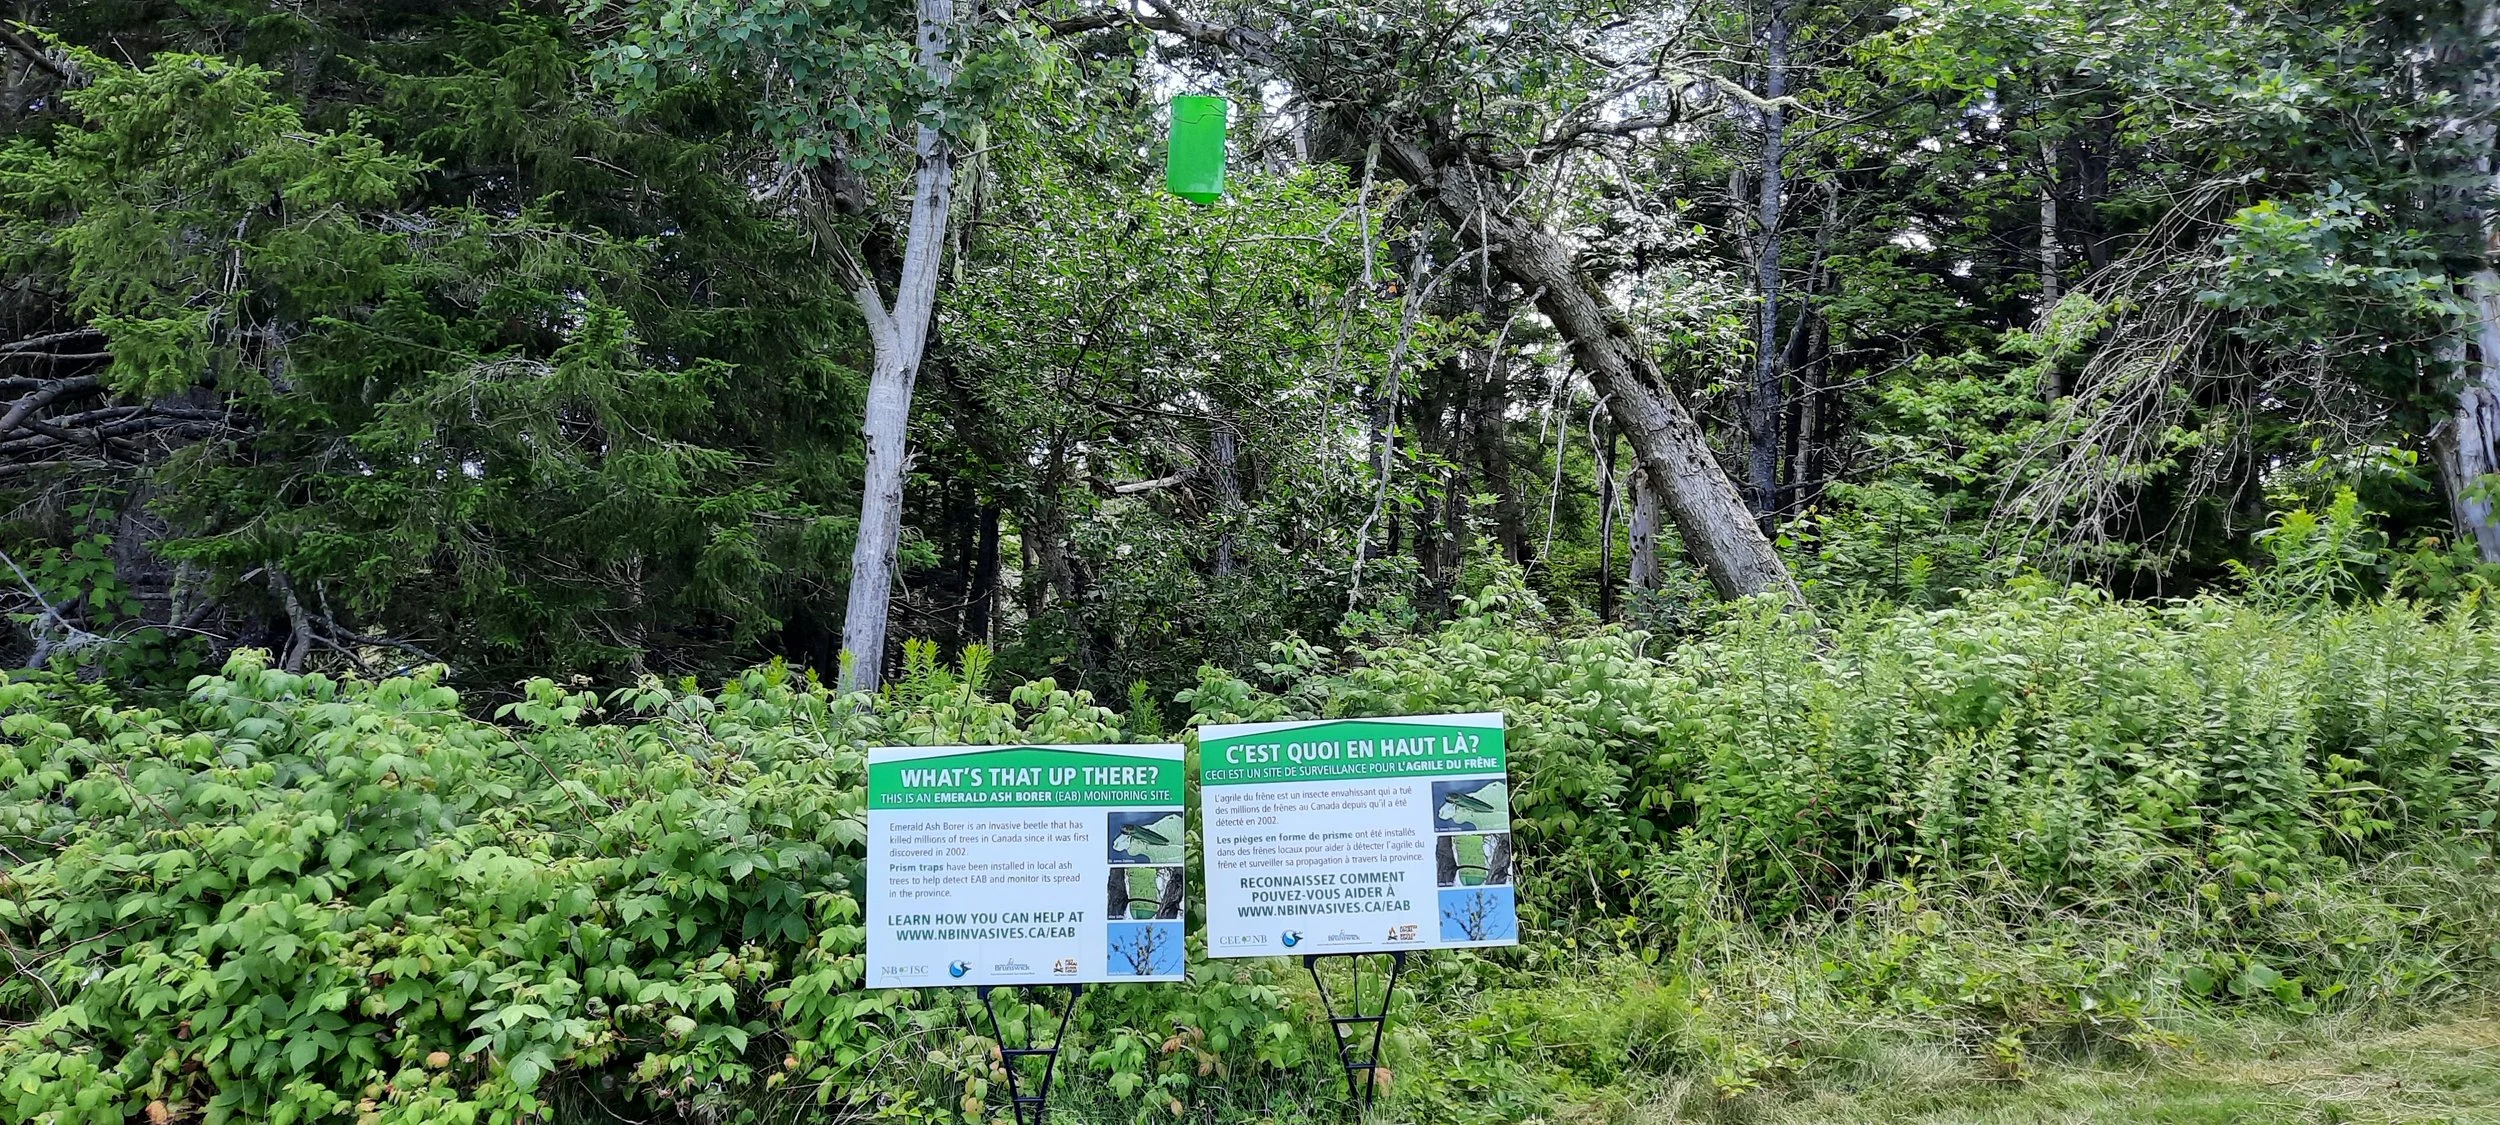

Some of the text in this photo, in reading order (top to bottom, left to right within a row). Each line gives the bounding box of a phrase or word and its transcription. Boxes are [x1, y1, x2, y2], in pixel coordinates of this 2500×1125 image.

[1226, 731, 1479, 764] C'EST QUOI EN HAUT LÀ?
[1205, 756, 1500, 780] CECI EST UN SITE DE SURVEILLANCE POUR L'AGRILE DU FRÊNE.
[901, 765, 1159, 788] WHAT'S THAT UP THERE?
[881, 790, 1173, 804] THIS IS AN EMERALD ASH BORER (EAB) MONITORING SITE.
[1215, 792, 1241, 804] L'agrile
[1244, 792, 1253, 801] du
[1256, 791, 1274, 801] frêne
[1277, 791, 1288, 799] est
[1302, 789, 1329, 798] insecte
[1331, 788, 1376, 797] envahissant
[1379, 787, 1390, 797] qui
[1399, 785, 1412, 795] tué
[1215, 805, 1228, 814] des
[1230, 804, 1260, 813] millions
[1262, 803, 1272, 812] de
[1274, 802, 1297, 812] frênes
[1310, 800, 1340, 810] Canada
[1342, 800, 1366, 811] depuis
[1369, 799, 1386, 810] qu'il
[1395, 798, 1407, 807] été
[889, 822, 923, 831] Emerald
[925, 821, 941, 831] Ash
[943, 821, 965, 830] Borer
[967, 821, 973, 830] is
[989, 820, 1021, 830] invasive
[1023, 820, 1048, 829] beetle
[1050, 820, 1067, 829] that
[1069, 820, 1083, 829] has
[1216, 816, 1279, 827] détecté en 2002.
[889, 835, 912, 844] killed
[914, 834, 946, 843] millions
[949, 834, 957, 843] of
[959, 835, 979, 843] trees
[981, 834, 989, 842] in
[991, 834, 1022, 842] Canada
[1024, 834, 1045, 842] since
[1047, 833, 1053, 842] it
[1074, 833, 1089, 841] first
[1217, 836, 1231, 845] Les
[1233, 834, 1264, 846] pièges
[1279, 833, 1307, 842] forme
[1309, 832, 1320, 841] de
[1322, 831, 1353, 842] prisme
[1370, 829, 1383, 838] été
[1385, 828, 1415, 837] installés
[889, 847, 969, 857] discovered in 2002.
[1217, 840, 1424, 856] dans des frênes locaux pour aider à détecter l'agrile du
[890, 861, 1072, 874] Prism traps have been installed in local ash
[1218, 860, 1237, 869] frêne
[1239, 860, 1247, 868] et
[1249, 858, 1283, 868] surveiller
[1296, 856, 1342, 867] propagation
[1345, 856, 1350, 864] à
[1352, 855, 1378, 864] travers
[1380, 854, 1388, 862] la
[1390, 853, 1424, 864] province.
[889, 873, 1080, 886] trees to help detect EAB and monitor its spread
[1240, 871, 1405, 889] RECONNAISSEZ COMMENT
[889, 888, 952, 899] in the province.
[1252, 883, 1395, 903] POUVEZ-VOUS AIDER À
[1237, 901, 1411, 917] WWW.NBINVASIVES.CA/EAB
[888, 912, 1084, 926] LEARN HOW YOU CAN HELP AT
[896, 927, 1075, 941] WWW.NBINVASIVES.CA/EAB
